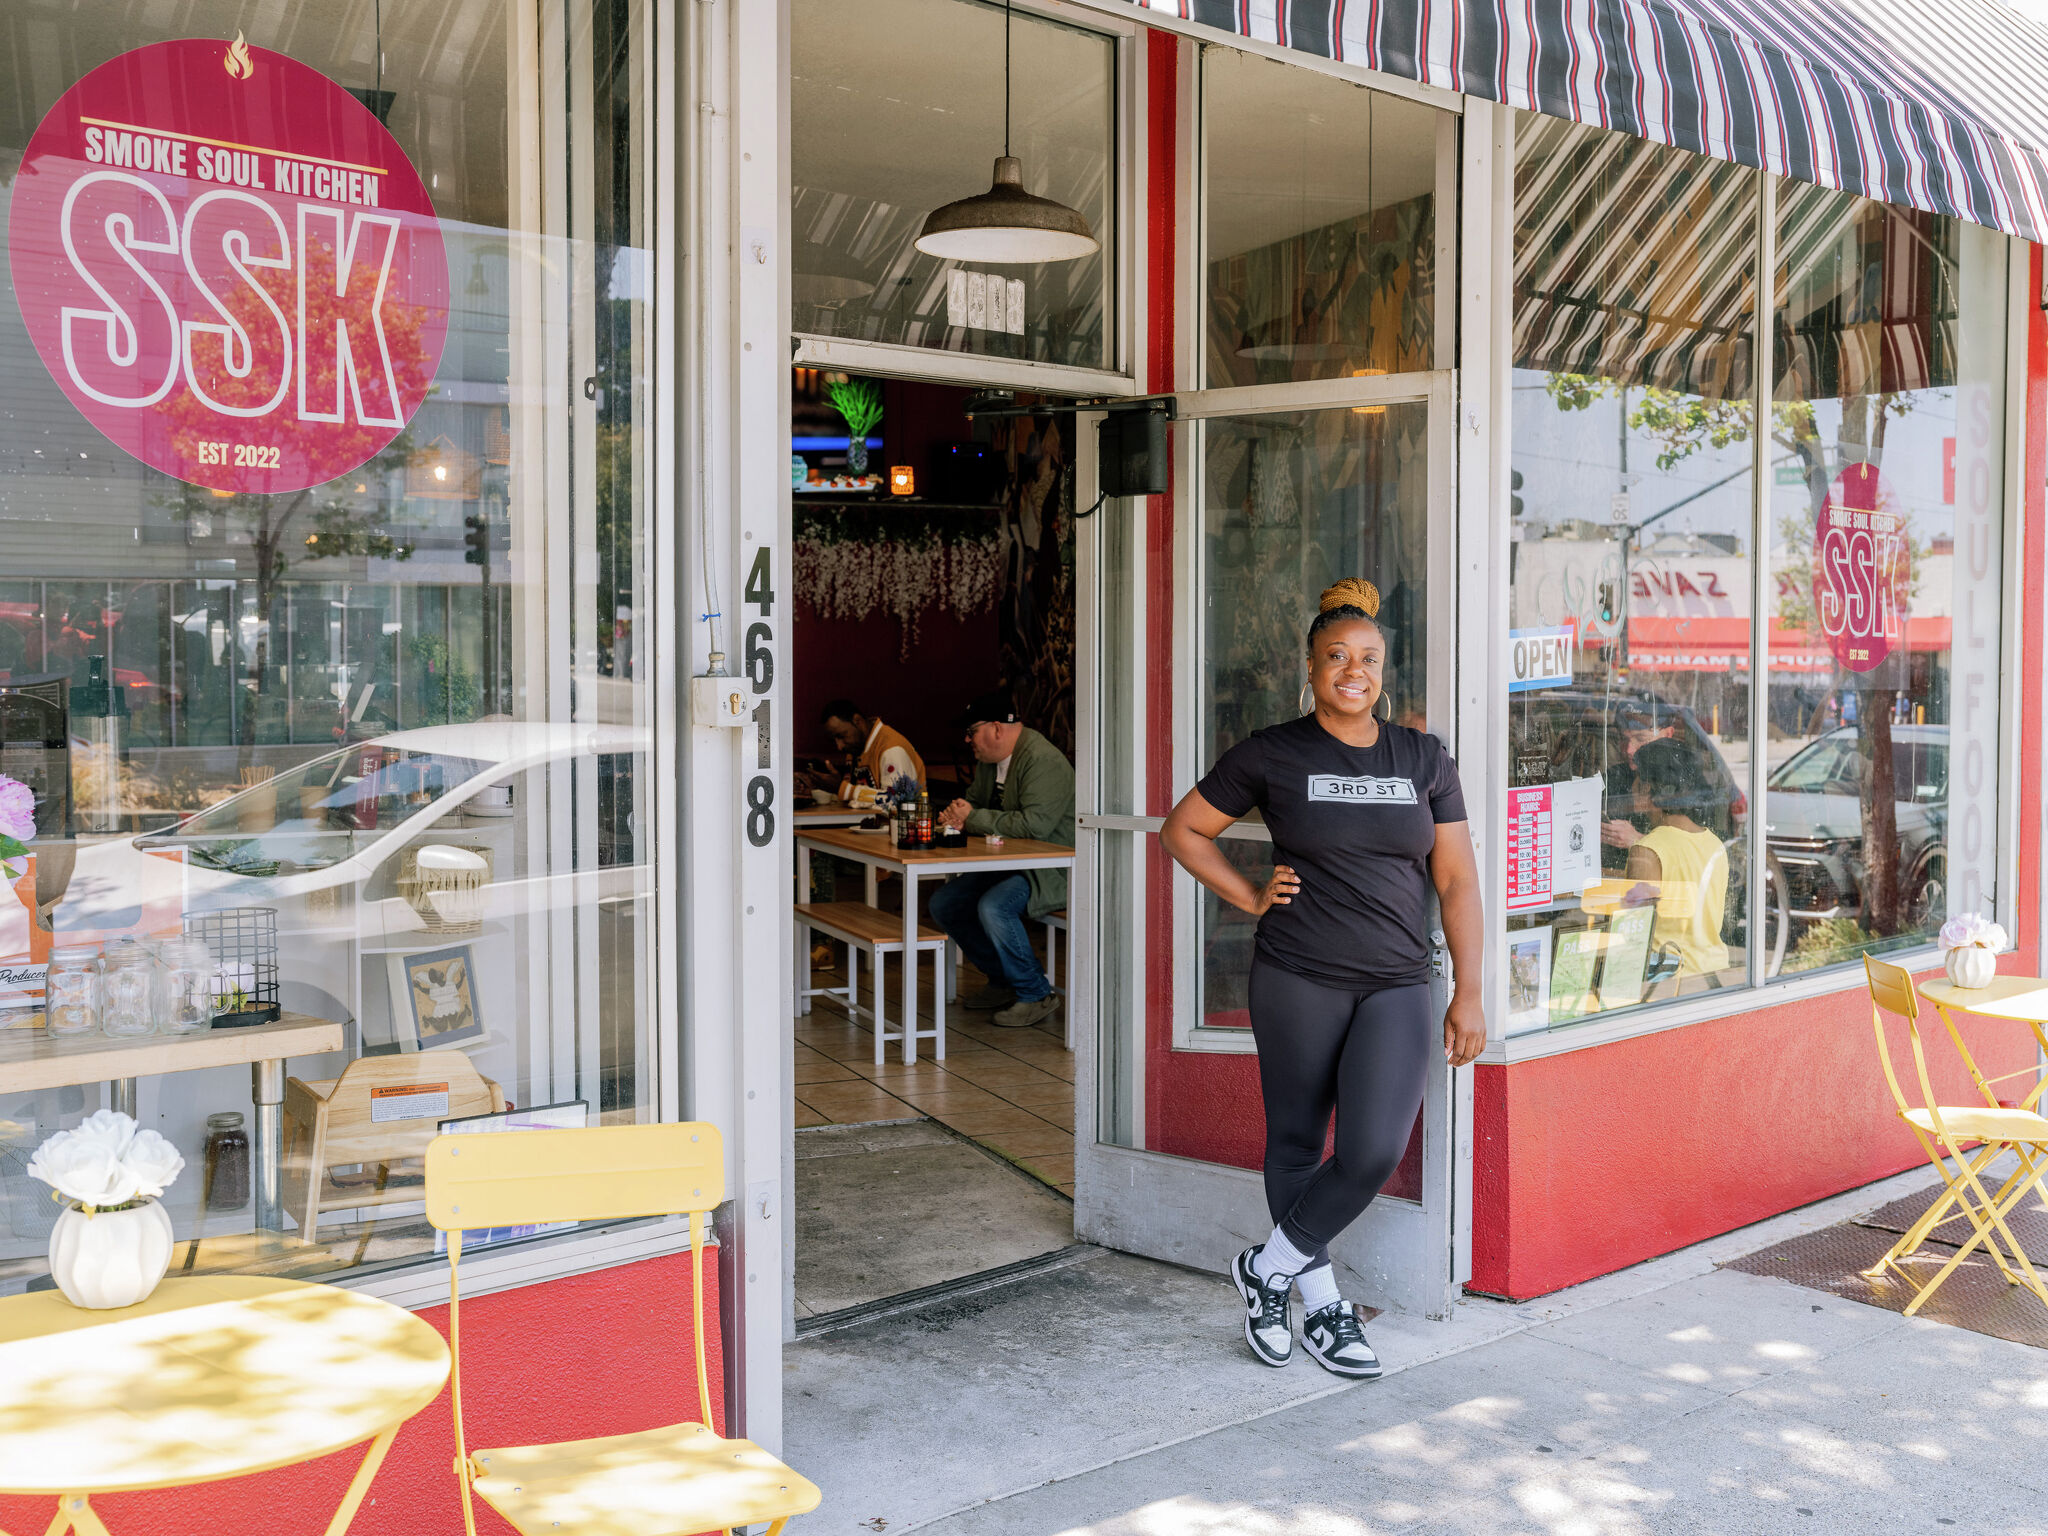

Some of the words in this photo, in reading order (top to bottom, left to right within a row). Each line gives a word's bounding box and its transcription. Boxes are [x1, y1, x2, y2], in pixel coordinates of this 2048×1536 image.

[85, 127, 187, 176] SMOKE
[197, 146, 265, 189] SOUL
[275, 159, 379, 207] KITCHEN
[60, 170, 405, 428] SSK
[198, 441, 229, 465] EST
[234, 444, 281, 469] 2022
[1829, 509, 1852, 528] SMOKE
[1853, 512, 1869, 530] SOUL
[1870, 514, 1895, 533] KITCHEN
[1967, 388, 1991, 648] SOUL
[1821, 528, 1900, 638] SSK
[1513, 637, 1569, 680] OPEN
[1849, 649, 1858, 660] EST
[1858, 650, 1869, 661] 2022
[744, 546, 776, 848] 4618
[1328, 782, 1368, 796] 3RD
[1376, 784, 1397, 796] ST
[1517, 792, 1544, 802] BUSINESS
[1520, 802, 1540, 812] HOURS:
[1618, 920, 1644, 934] PASS
[1562, 941, 1592, 956] PASS
